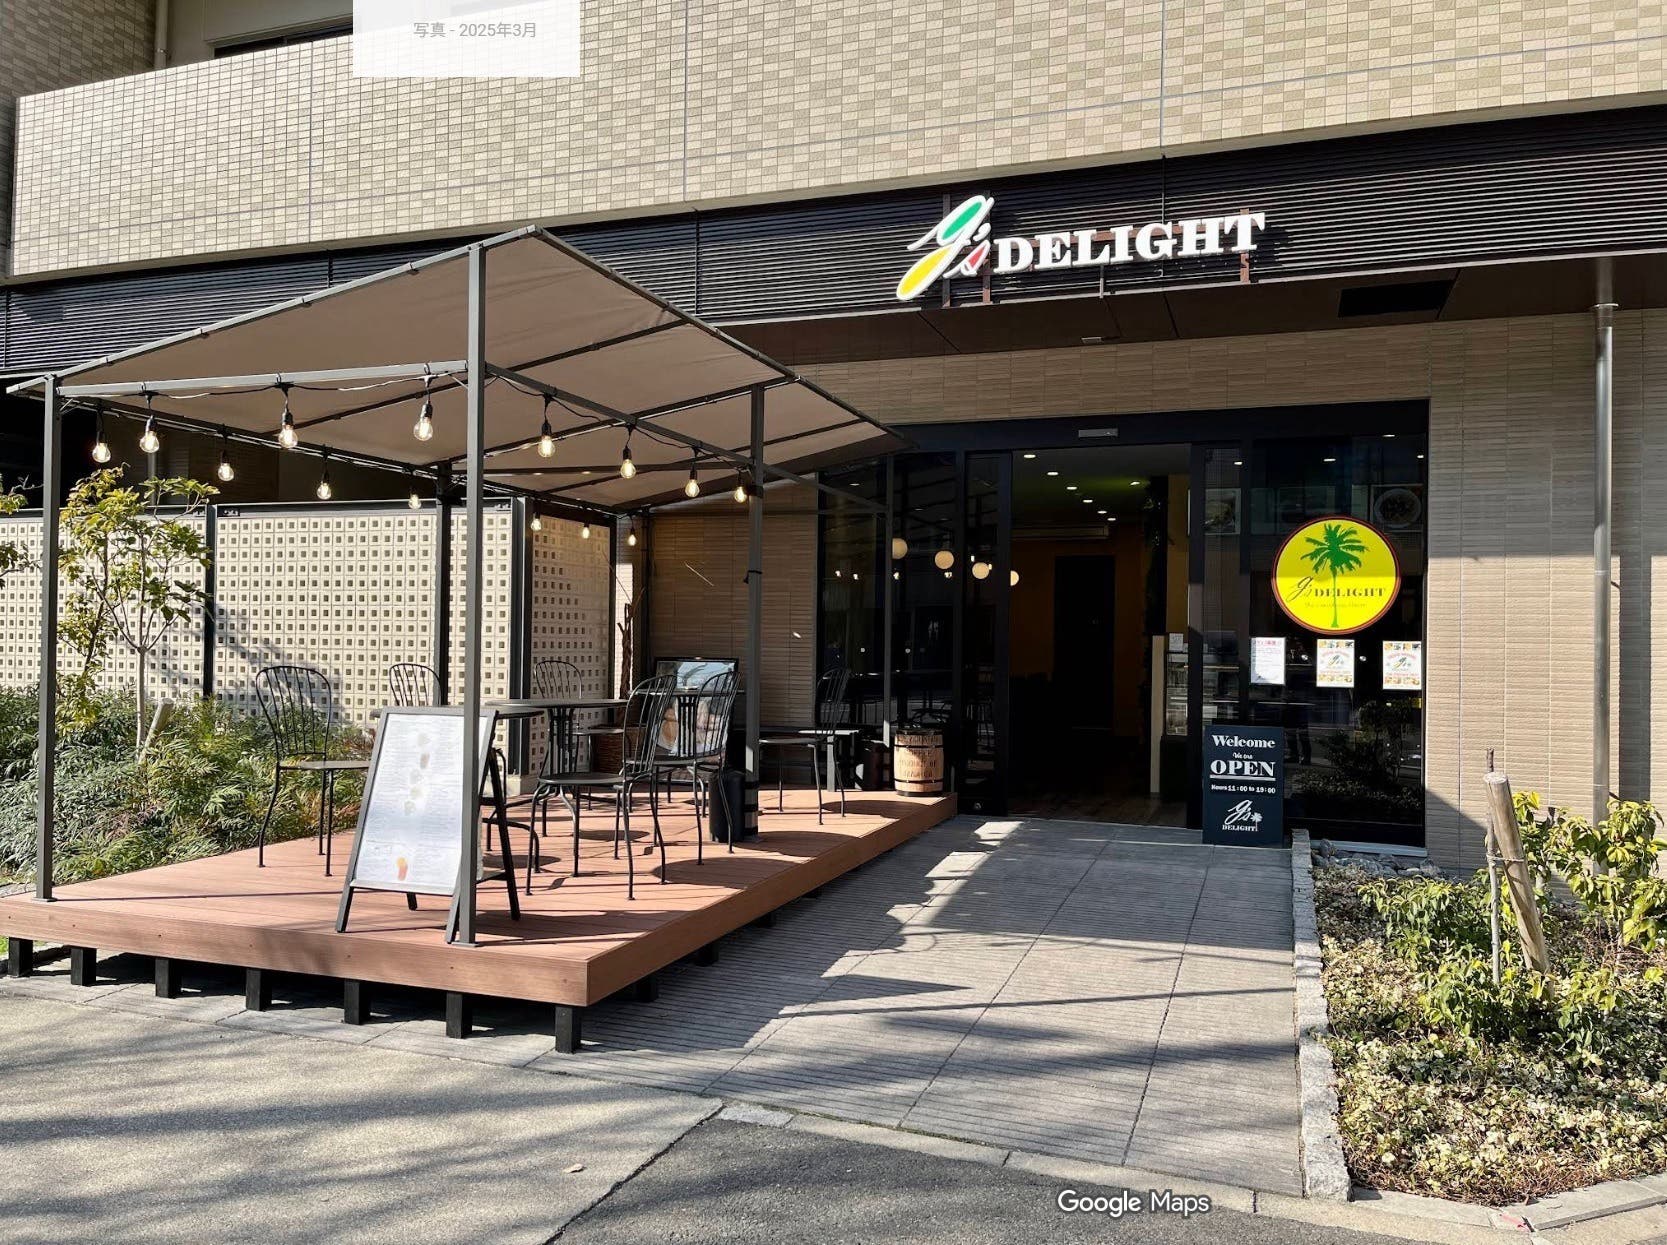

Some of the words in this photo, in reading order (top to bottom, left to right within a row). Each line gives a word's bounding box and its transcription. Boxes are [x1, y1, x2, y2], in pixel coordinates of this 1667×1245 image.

[994, 212, 1265, 273] DELIGHT
[1314, 587, 1386, 597] DELIGHT
[1211, 734, 1276, 749] Welcome
[1210, 760, 1276, 776] OPEN
[1222, 824, 1256, 832] DELIGHT
